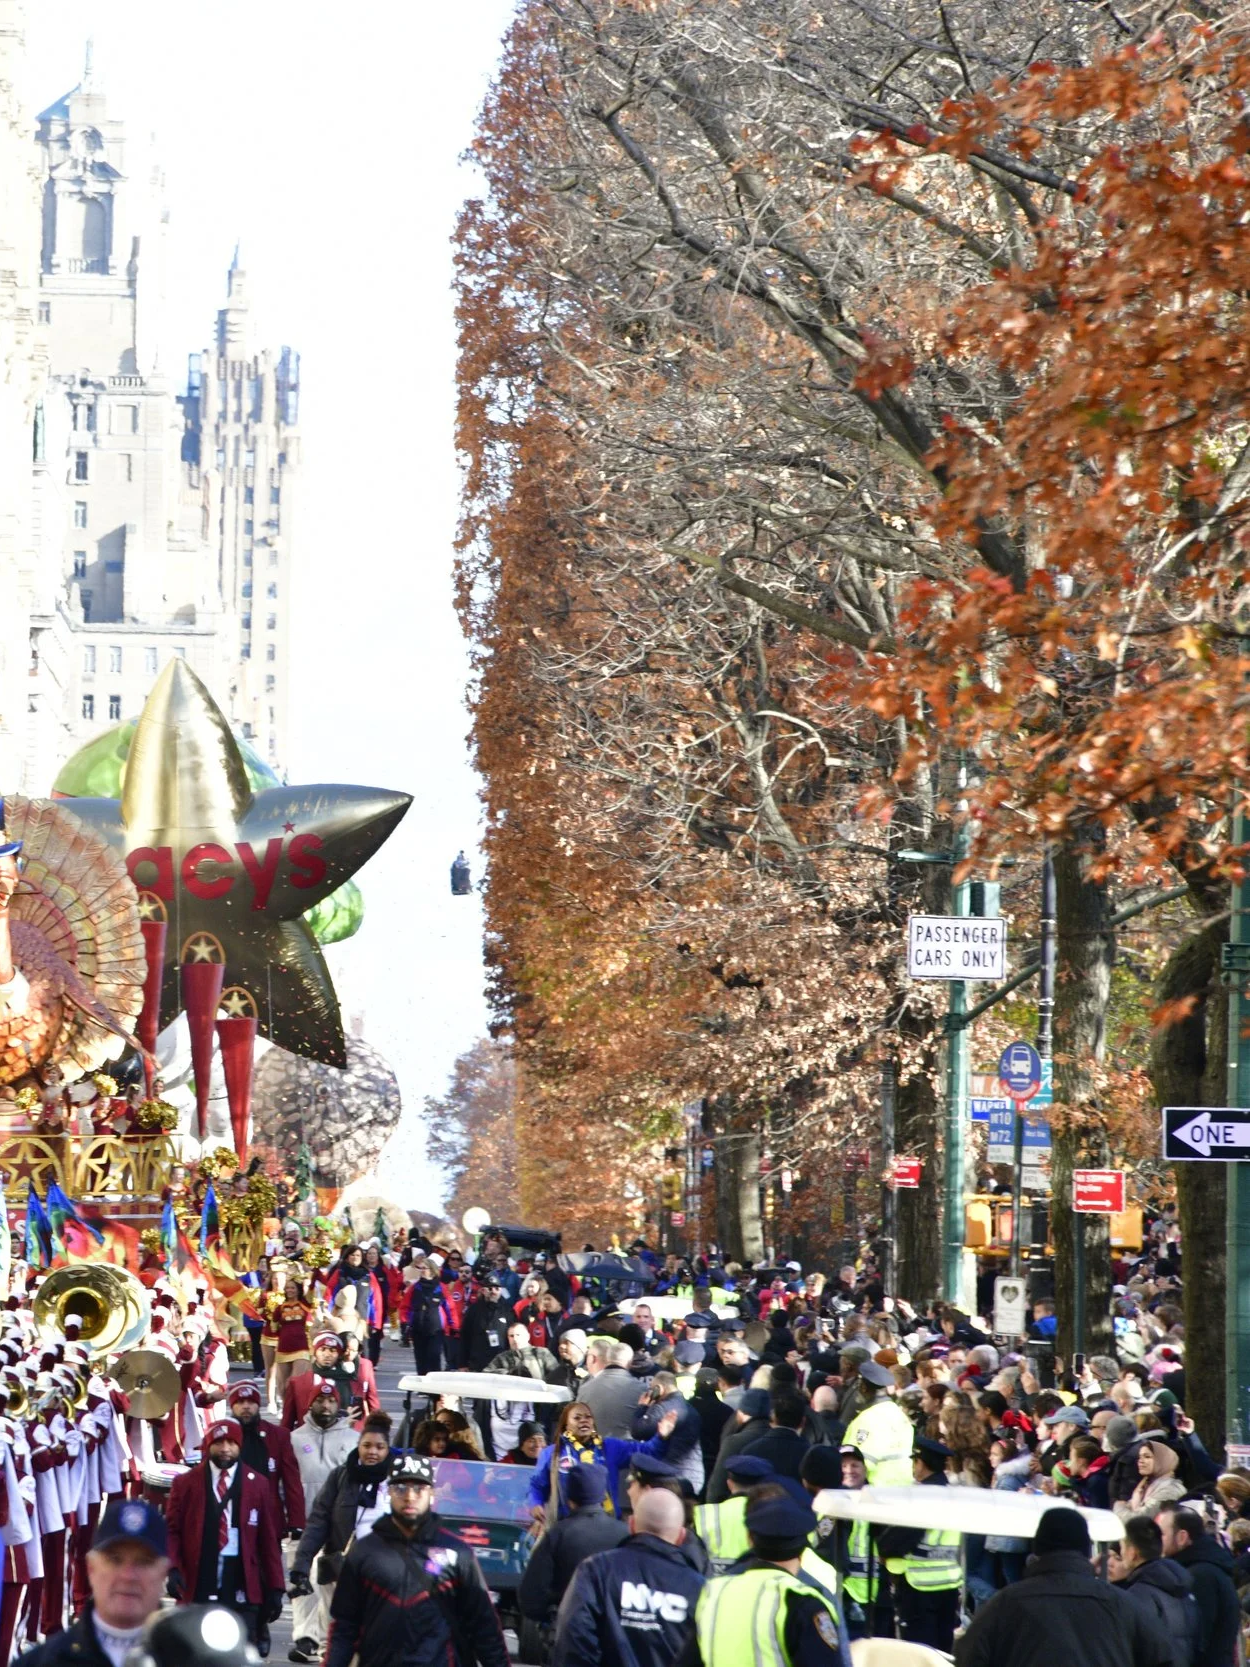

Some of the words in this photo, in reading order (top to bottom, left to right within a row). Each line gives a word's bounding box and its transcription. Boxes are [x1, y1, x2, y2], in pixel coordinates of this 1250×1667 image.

[125, 821, 328, 911] acy's
[916, 925, 998, 944] PASSENGER
[915, 949, 952, 967] CARS
[962, 950, 997, 968] ONLY
[1191, 1125, 1235, 1143] ONE
[620, 1581, 688, 1624] NYC
